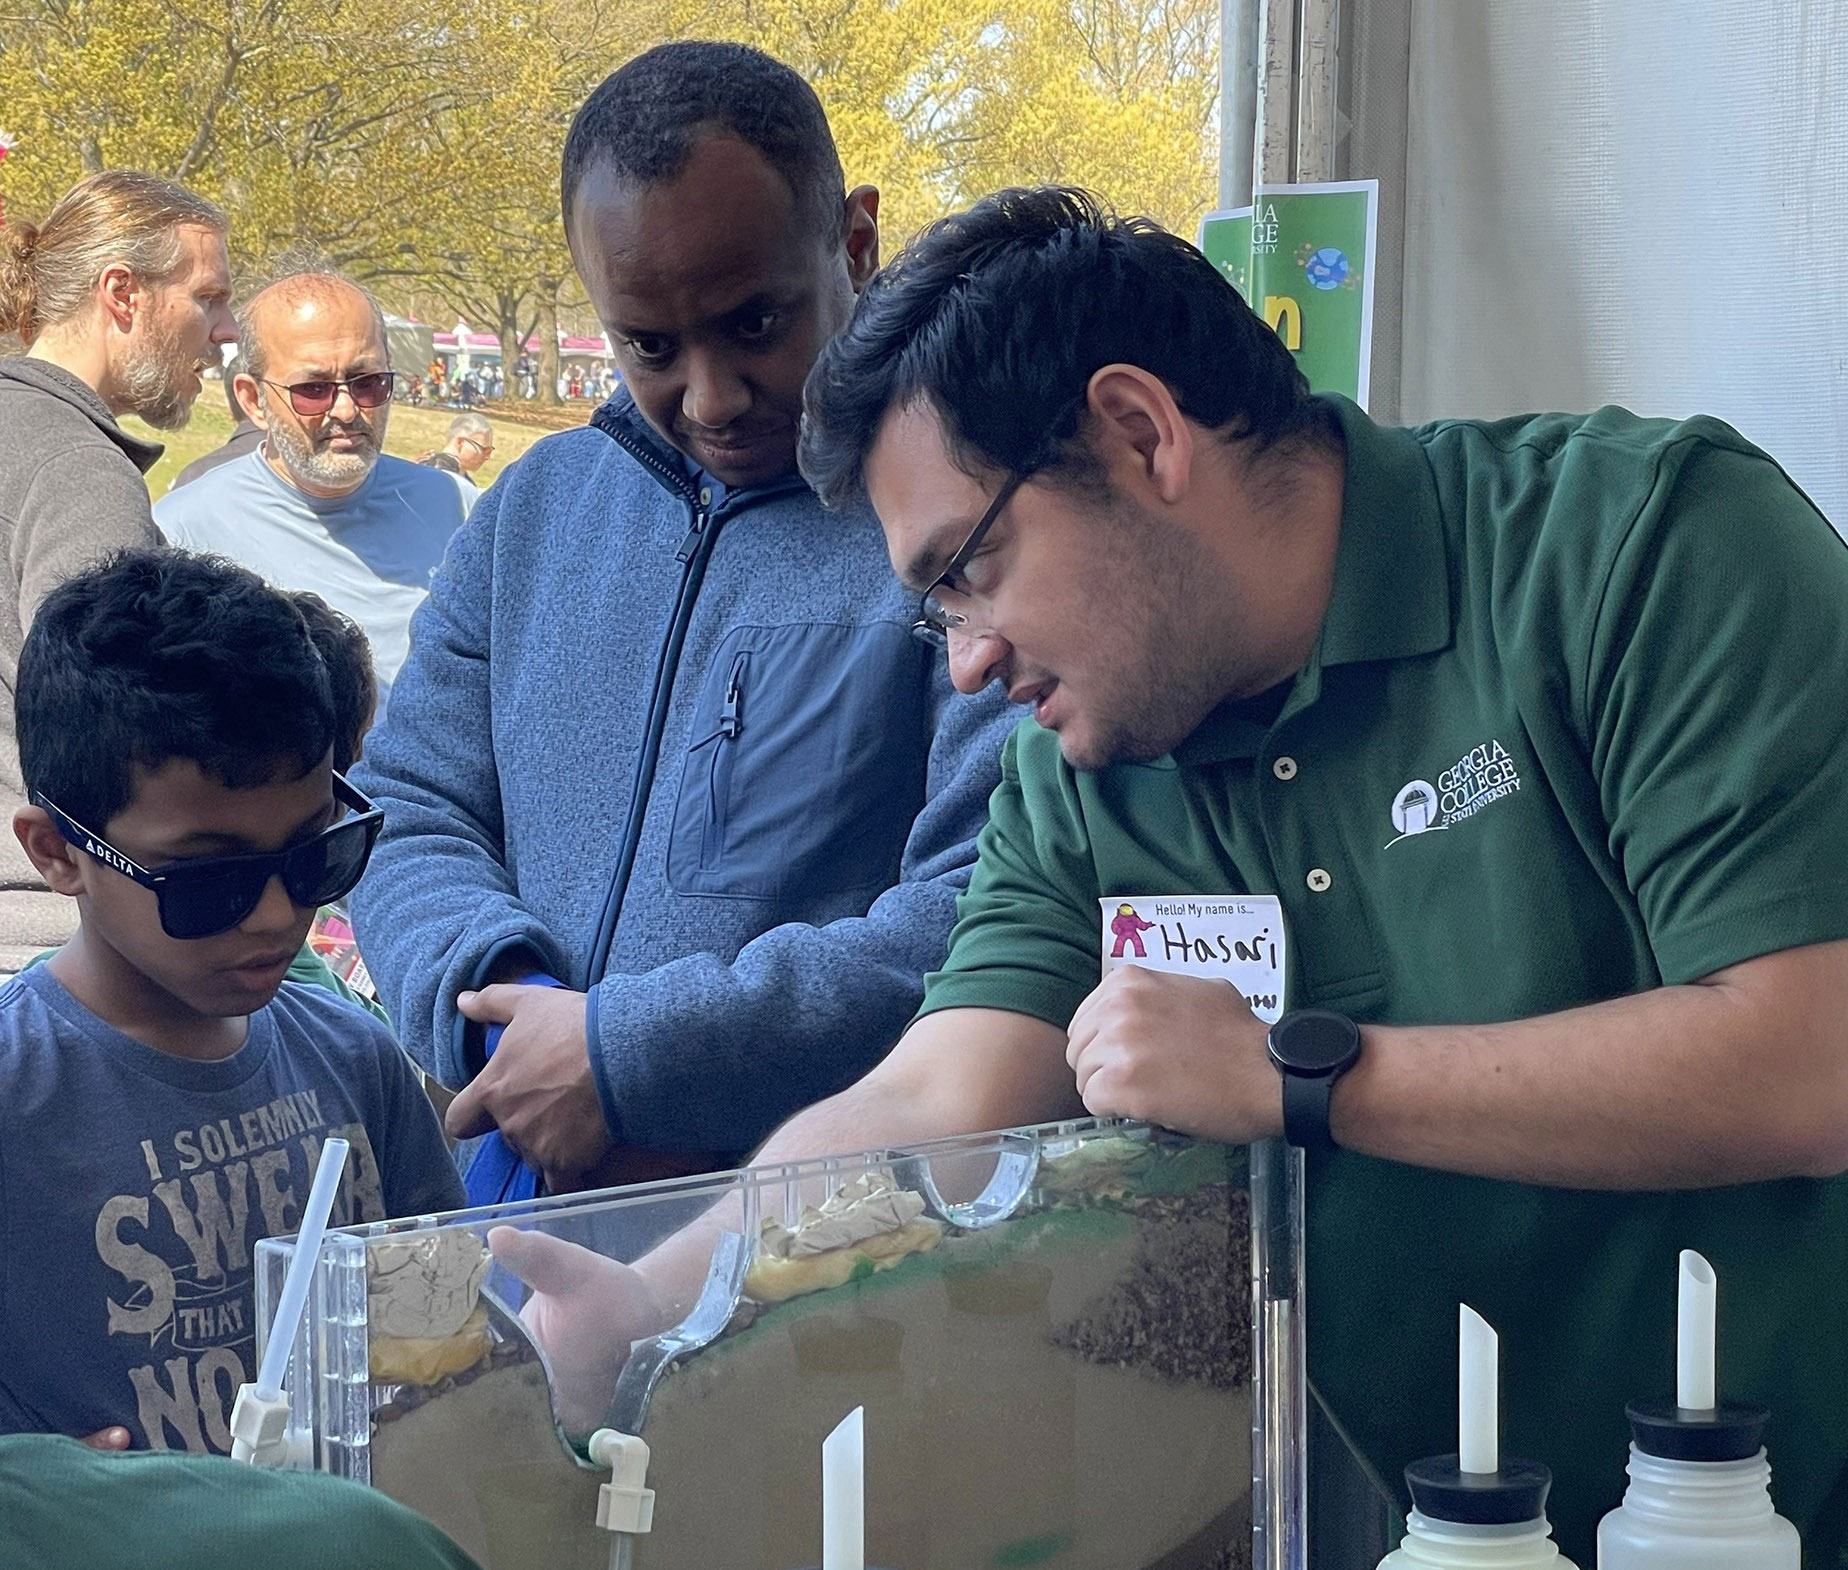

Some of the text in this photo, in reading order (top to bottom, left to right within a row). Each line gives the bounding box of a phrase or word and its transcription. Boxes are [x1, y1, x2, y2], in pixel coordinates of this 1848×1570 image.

[1438, 739, 1511, 793] GEORGIA
[1440, 758, 1518, 813] COLLEGE
[96, 845, 134, 877] DELTA
[1155, 903, 1186, 916] Hello!
[1188, 903, 1202, 918] My
[1205, 904, 1234, 915] name
[140, 1089, 326, 1181] I SOLEMNLY
[178, 1300, 244, 1340] THAT
